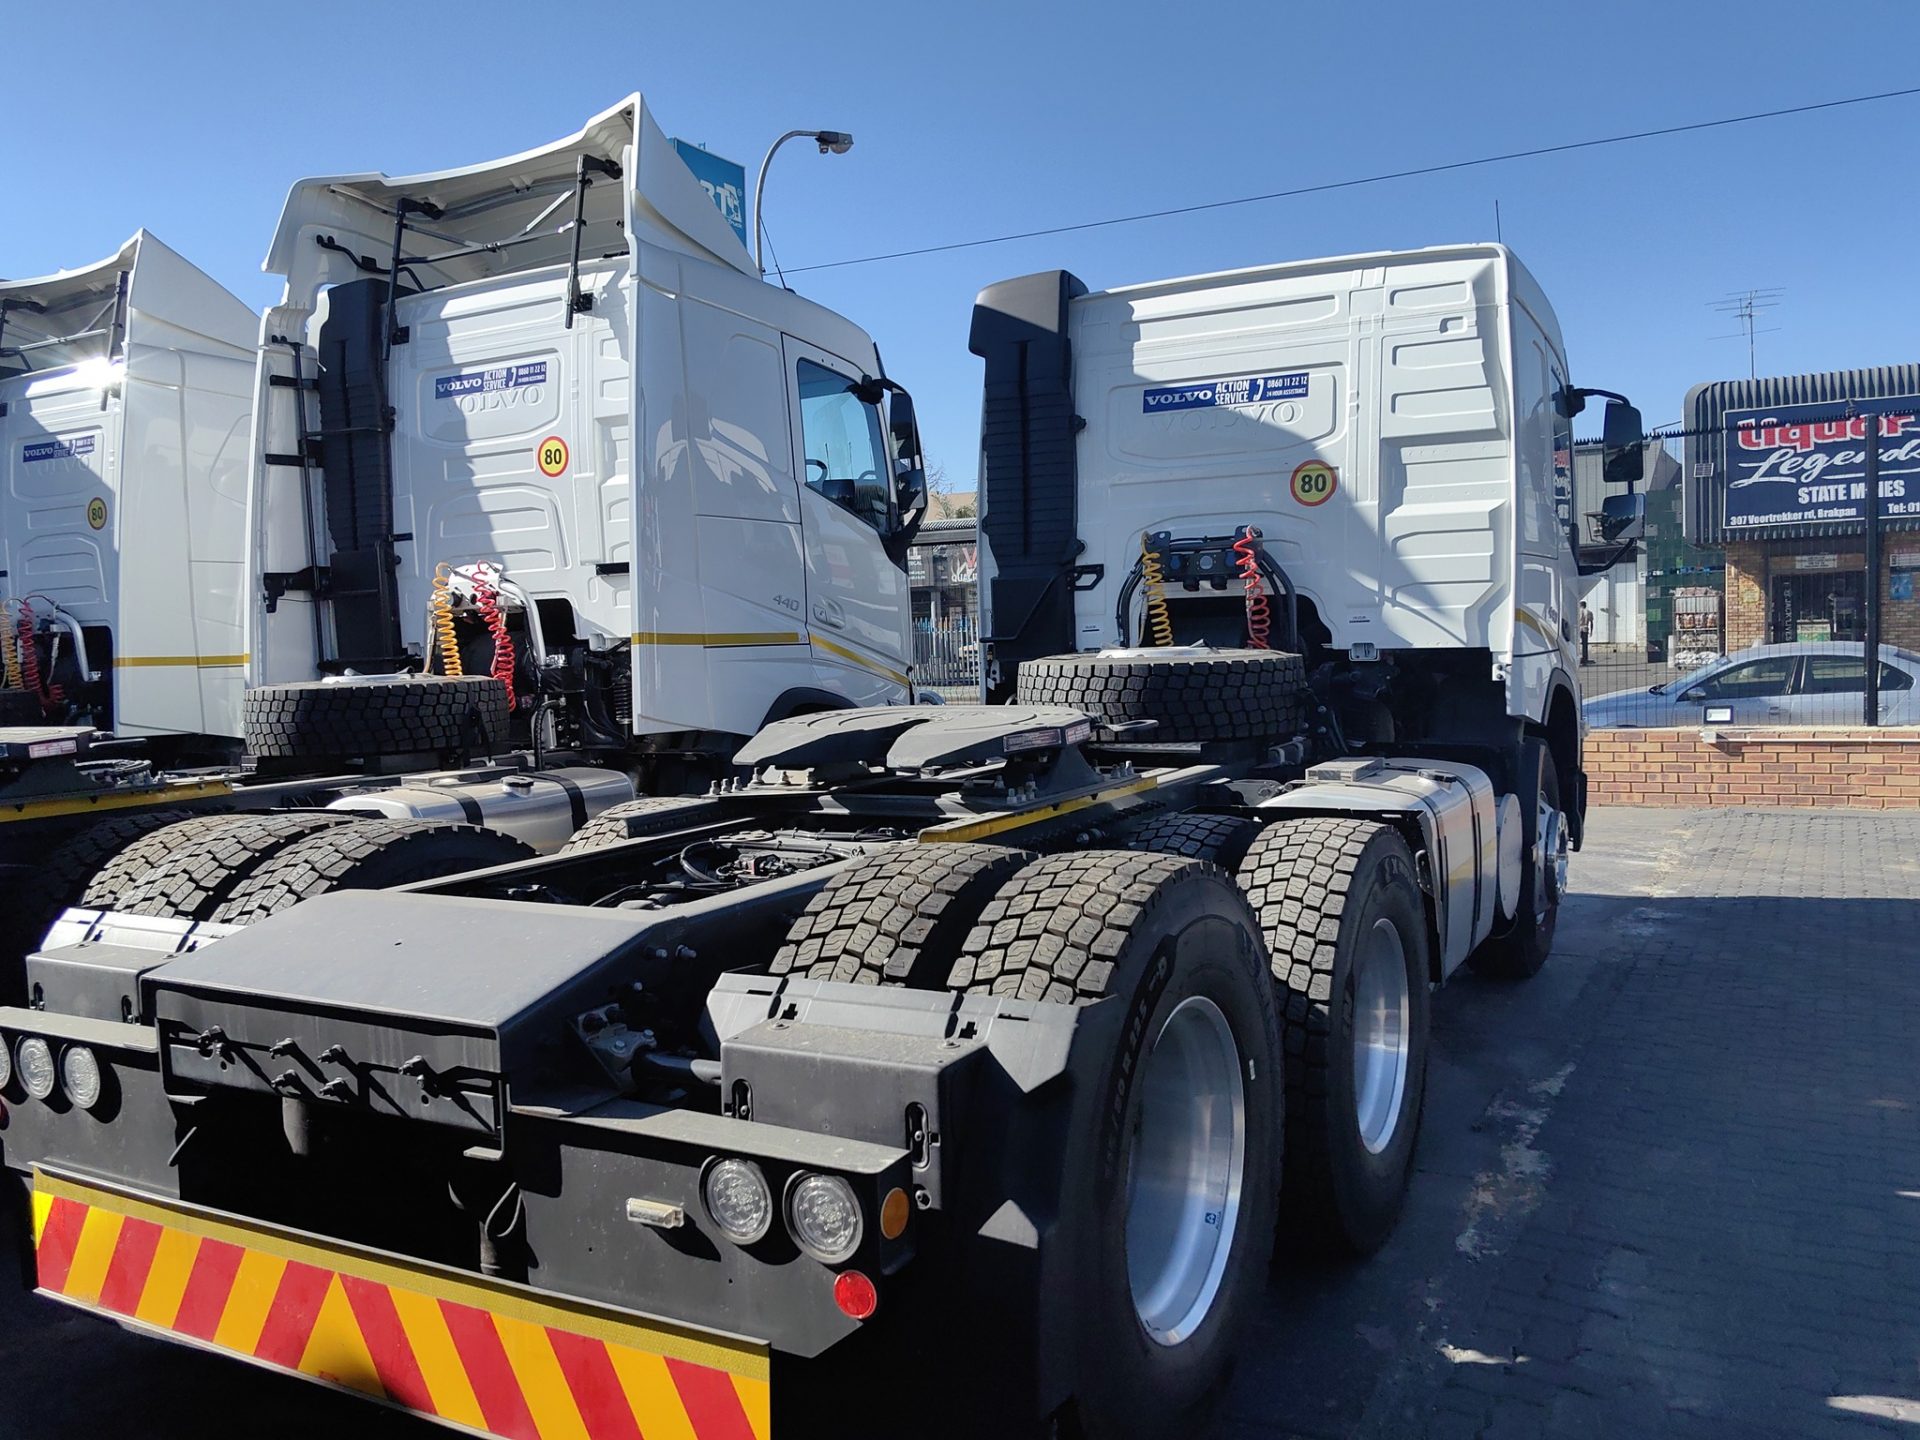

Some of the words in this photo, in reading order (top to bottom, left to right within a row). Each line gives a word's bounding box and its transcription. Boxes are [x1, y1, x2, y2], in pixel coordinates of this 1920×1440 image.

[483, 368, 507, 381] ACTION
[1267, 378, 1283, 389] 0860
[1284, 377, 1290, 387] 11
[1291, 376, 1300, 386] 22
[1301, 375, 1308, 385] 12
[436, 377, 482, 393] VOLVO
[483, 378, 507, 392] SERVICE
[1214, 379, 1250, 394] ACTION
[1144, 389, 1213, 406] VOLVO
[1214, 391, 1250, 406] SERVICE
[23, 446, 54, 458] VOLVO
[544, 448, 562, 465] 80
[1300, 473, 1327, 494] 80
[1798, 483, 1848, 505] STATE
[1850, 480, 1905, 500] MES
[91, 506, 103, 521] 80
[1887, 502, 1907, 514] Tel:
[1730, 516, 1747, 526] 307
[1748, 511, 1803, 525] Voortrekker
[1817, 507, 1857, 518] Brakpan
[773, 594, 800, 612] 440
